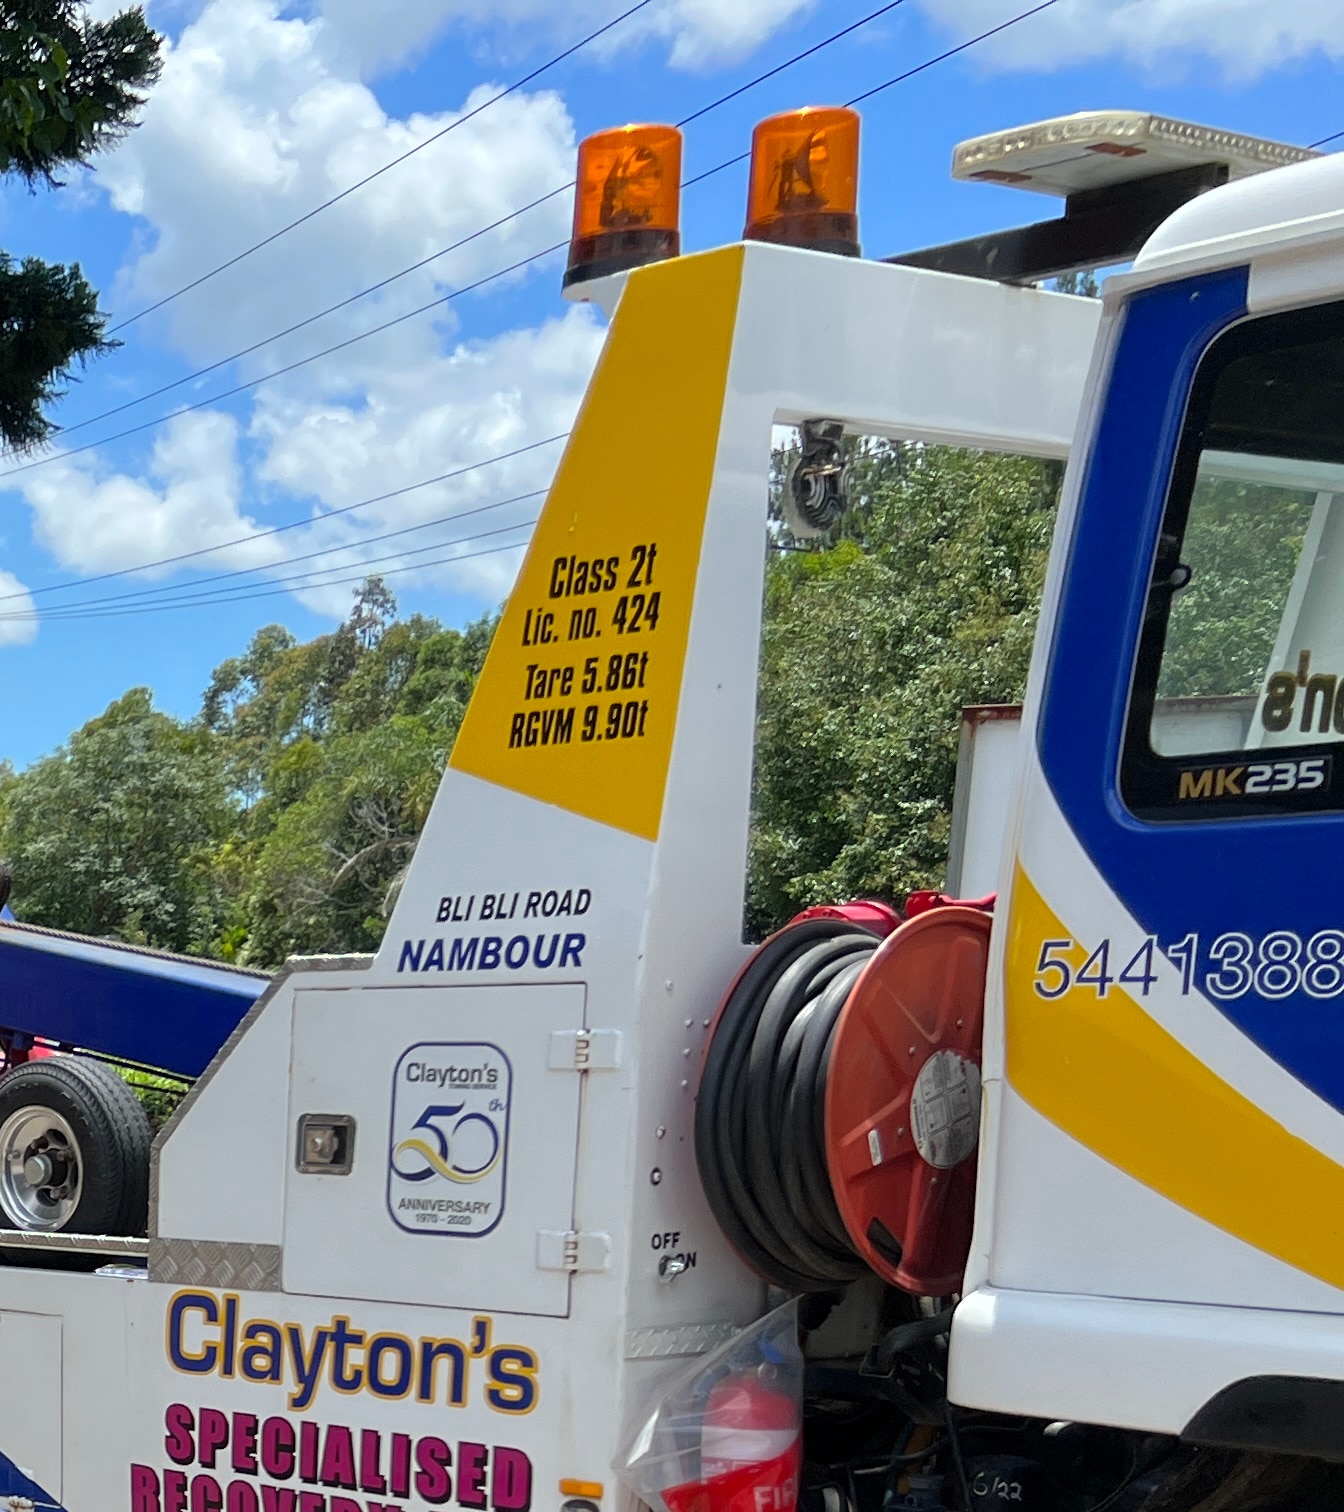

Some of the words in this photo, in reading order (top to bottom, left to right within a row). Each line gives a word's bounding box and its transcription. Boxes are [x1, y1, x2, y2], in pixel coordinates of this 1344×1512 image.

[549, 554, 620, 599] Class
[626, 543, 657, 588] 2t
[522, 607, 559, 647] Lic.
[567, 607, 602, 642] no.
[612, 592, 661, 634] 424
[524, 664, 574, 700] Tare
[581, 651, 649, 694] 5.86t
[508, 707, 576, 748] RGVM
[581, 700, 648, 742] 9.90t
[435, 894, 476, 923] BLI
[479, 892, 520, 921] BLI
[523, 888, 592, 918] ROAD
[396, 932, 587, 974] NAMBOUR
[405, 1062, 499, 1088] Clayton's
[398, 1197, 492, 1215] ANNIVERSARY
[651, 1231, 681, 1250] OFF
[164, 1287, 539, 1416] Clayton's
[973, 1471, 1022, 1501] 6/22
